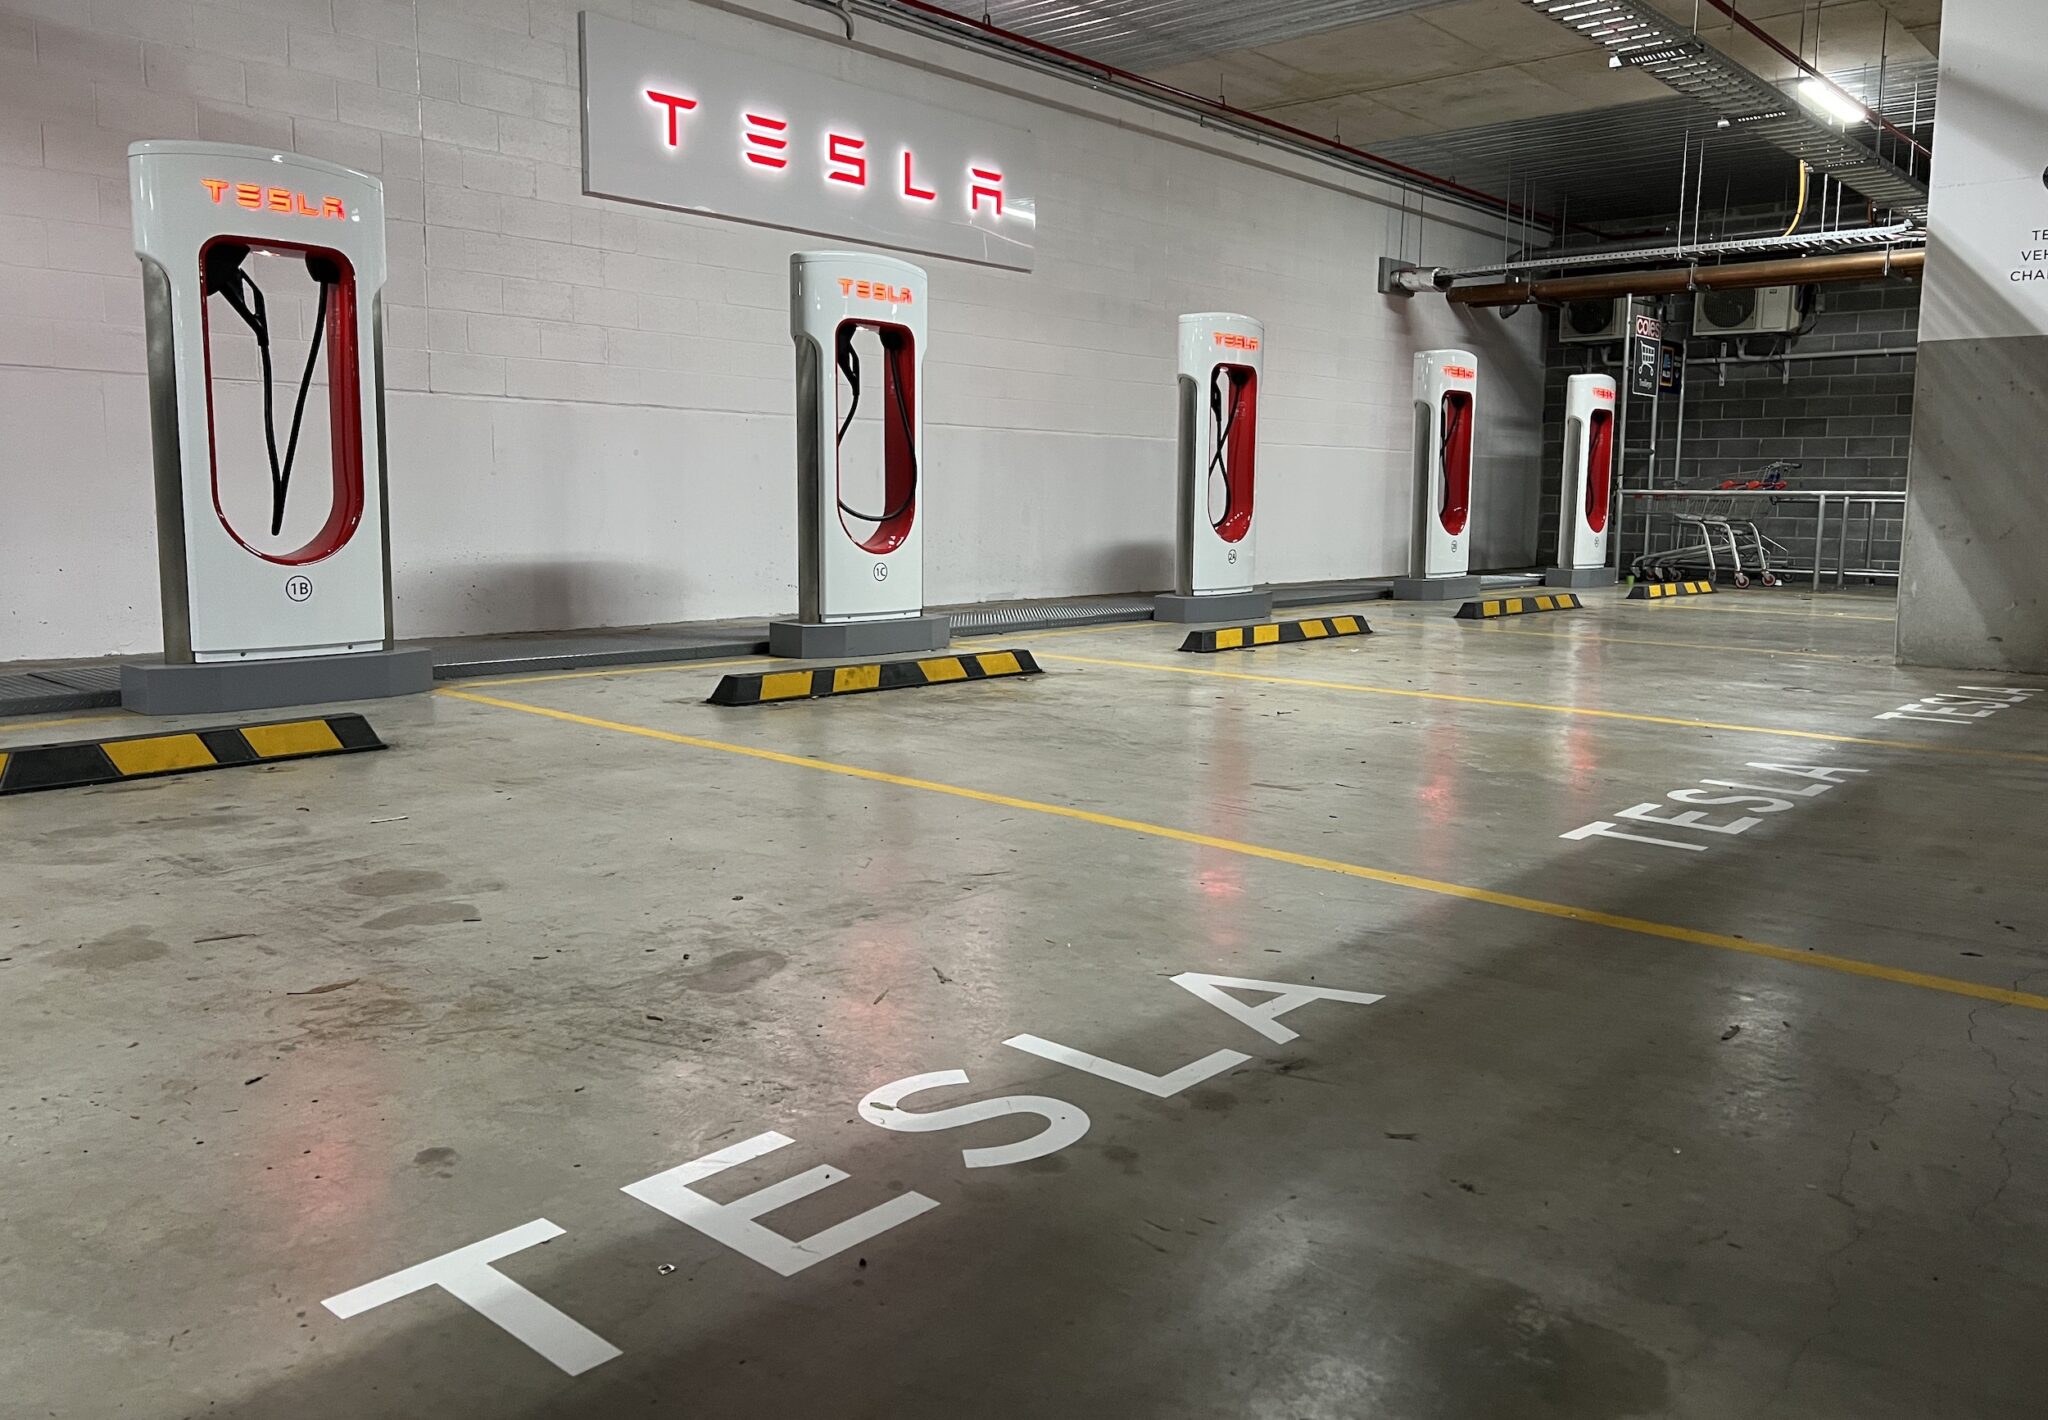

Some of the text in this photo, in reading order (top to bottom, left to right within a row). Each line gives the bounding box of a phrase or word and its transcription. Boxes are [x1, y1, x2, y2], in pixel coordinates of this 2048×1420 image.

[646, 90, 1003, 216] TESLA
[201, 179, 346, 220] TESLA
[838, 278, 912, 304] TESLA
[2010, 269, 2048, 281] CHA
[1214, 331, 1259, 350] TESLA
[1637, 319, 1660, 338] coles
[291, 582, 309, 595] 1B
[1872, 685, 2045, 724] TESLA
[1559, 762, 1870, 851] TESLA
[321, 972, 1386, 1377] TESLA
